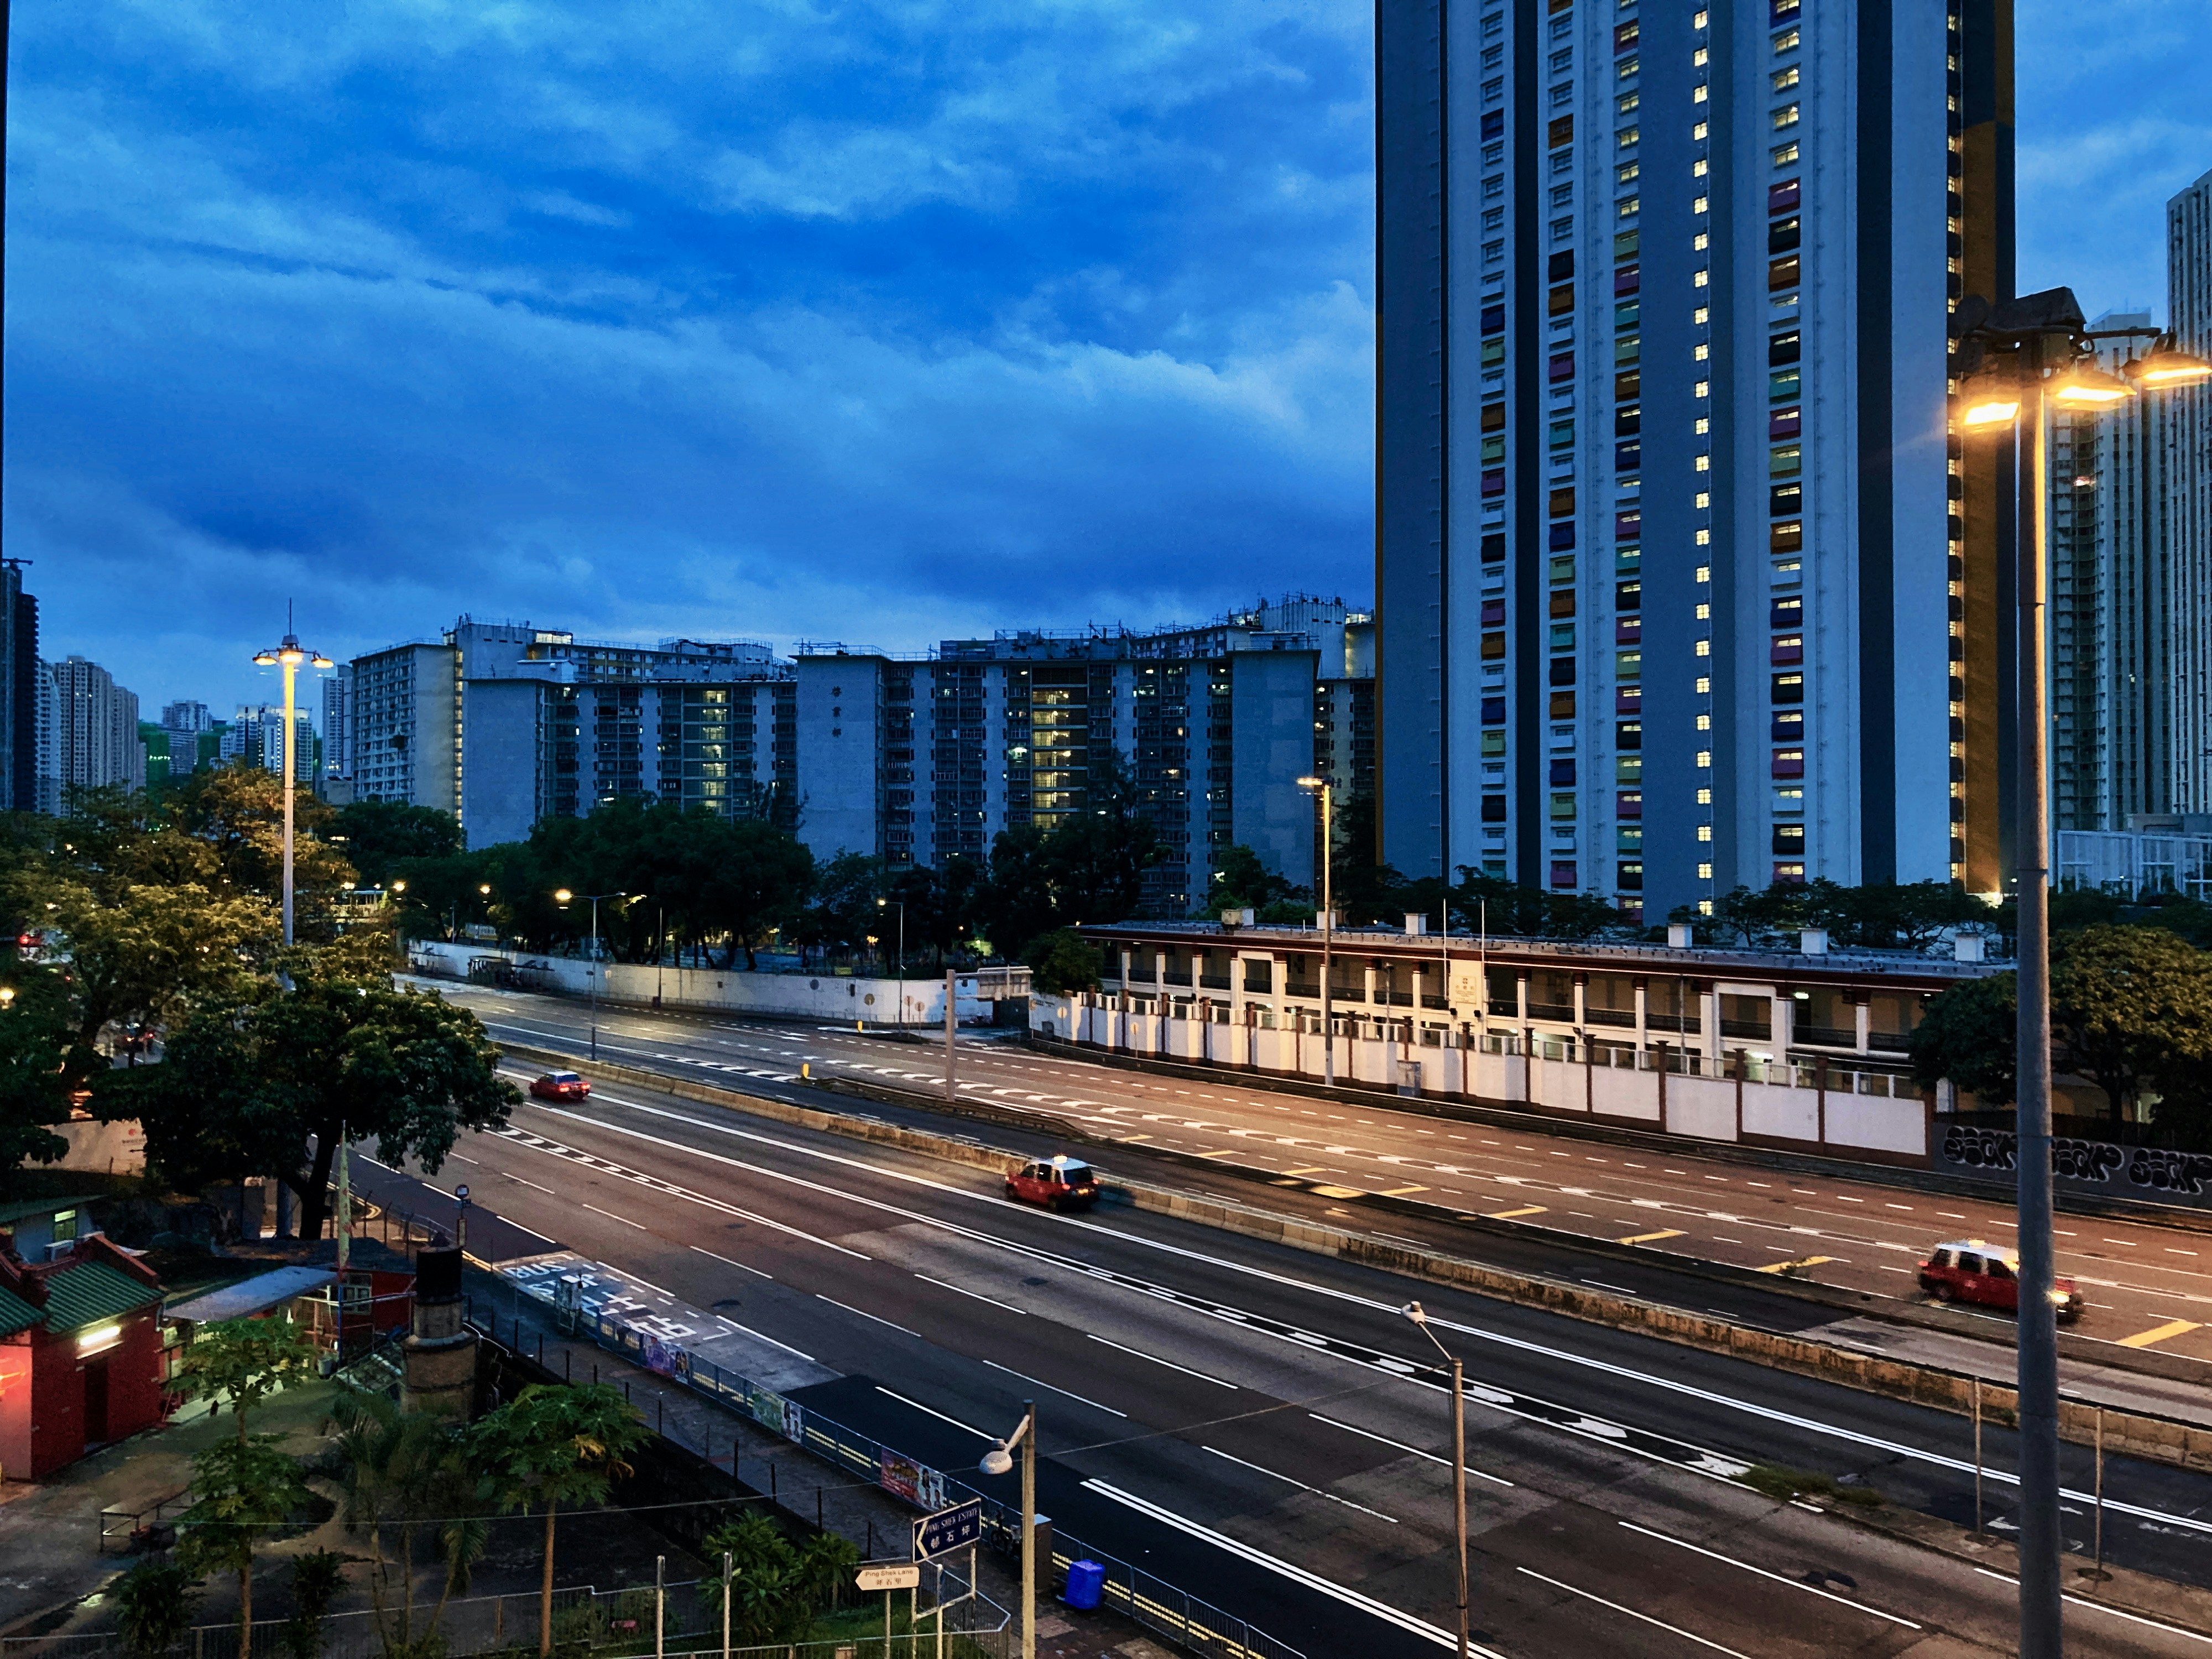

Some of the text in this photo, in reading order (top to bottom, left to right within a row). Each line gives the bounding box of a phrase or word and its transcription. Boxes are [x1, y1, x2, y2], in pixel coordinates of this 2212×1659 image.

[503, 1261, 567, 1279] BUS
[527, 1274, 599, 1297] STP
[941, 1516, 956, 1528] SHEK
[958, 1507, 979, 1522] ESTATE
